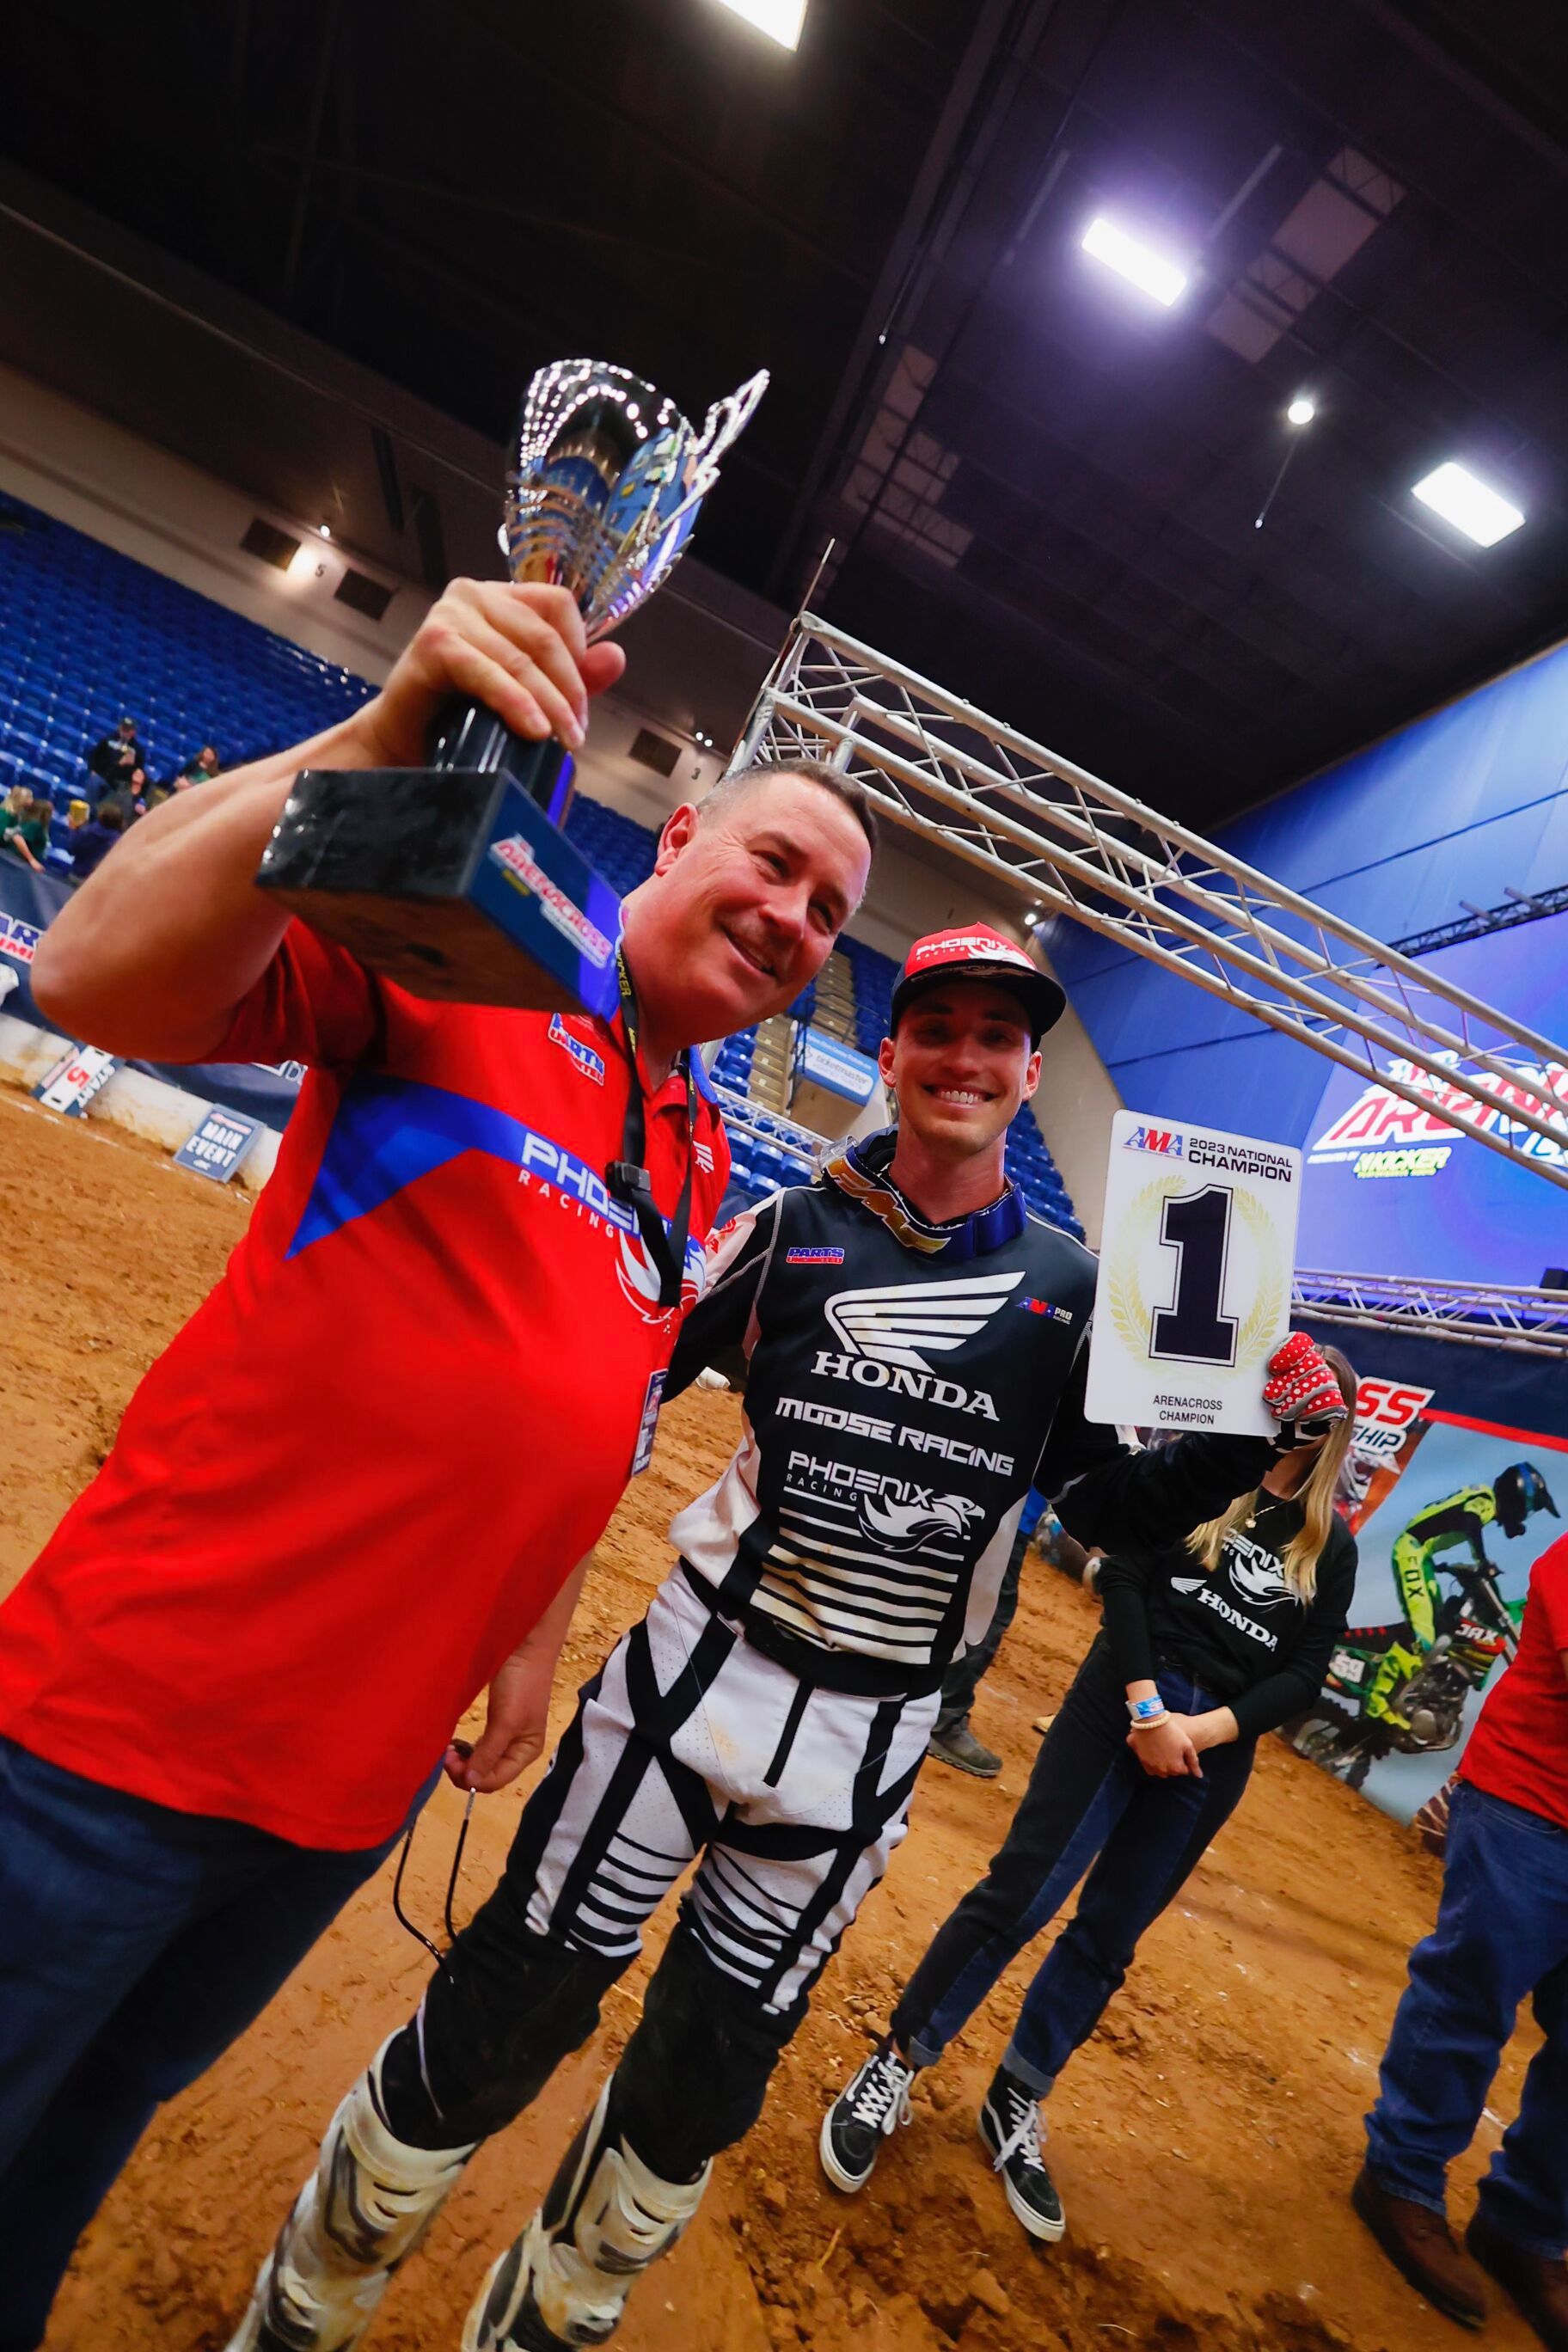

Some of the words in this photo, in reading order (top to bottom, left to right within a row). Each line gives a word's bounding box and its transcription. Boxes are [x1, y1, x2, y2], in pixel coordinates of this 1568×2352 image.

[916, 936, 1008, 956] PHOENIX
[186, 1134, 237, 1168] EVENT
[200, 1120, 243, 1152] MAIN
[1122, 1126, 1185, 1157] AMA
[1188, 1150, 1292, 1183] CHAMPION
[1190, 1137, 1225, 1154] 2023
[1228, 1146, 1293, 1168] NATIONAL
[518, 1169, 616, 1239] RACING
[787, 1246, 845, 1258] PARTS
[1148, 1184, 1240, 1368] 1
[1054, 1307, 1074, 1320] PRO
[810, 1351, 1001, 1422] HONDA
[1153, 1394, 1223, 1411] ARENACROSS
[1159, 1410, 1216, 1424] CHAMPION
[775, 1396, 897, 1443] MOOSE
[897, 1425, 1015, 1477] RACING
[786, 1473, 858, 1502] RACING
[787, 1450, 934, 1510] PHOENIX
[1404, 1554, 1425, 1600] FOX
[1197, 1587, 1279, 1652] HONDA
